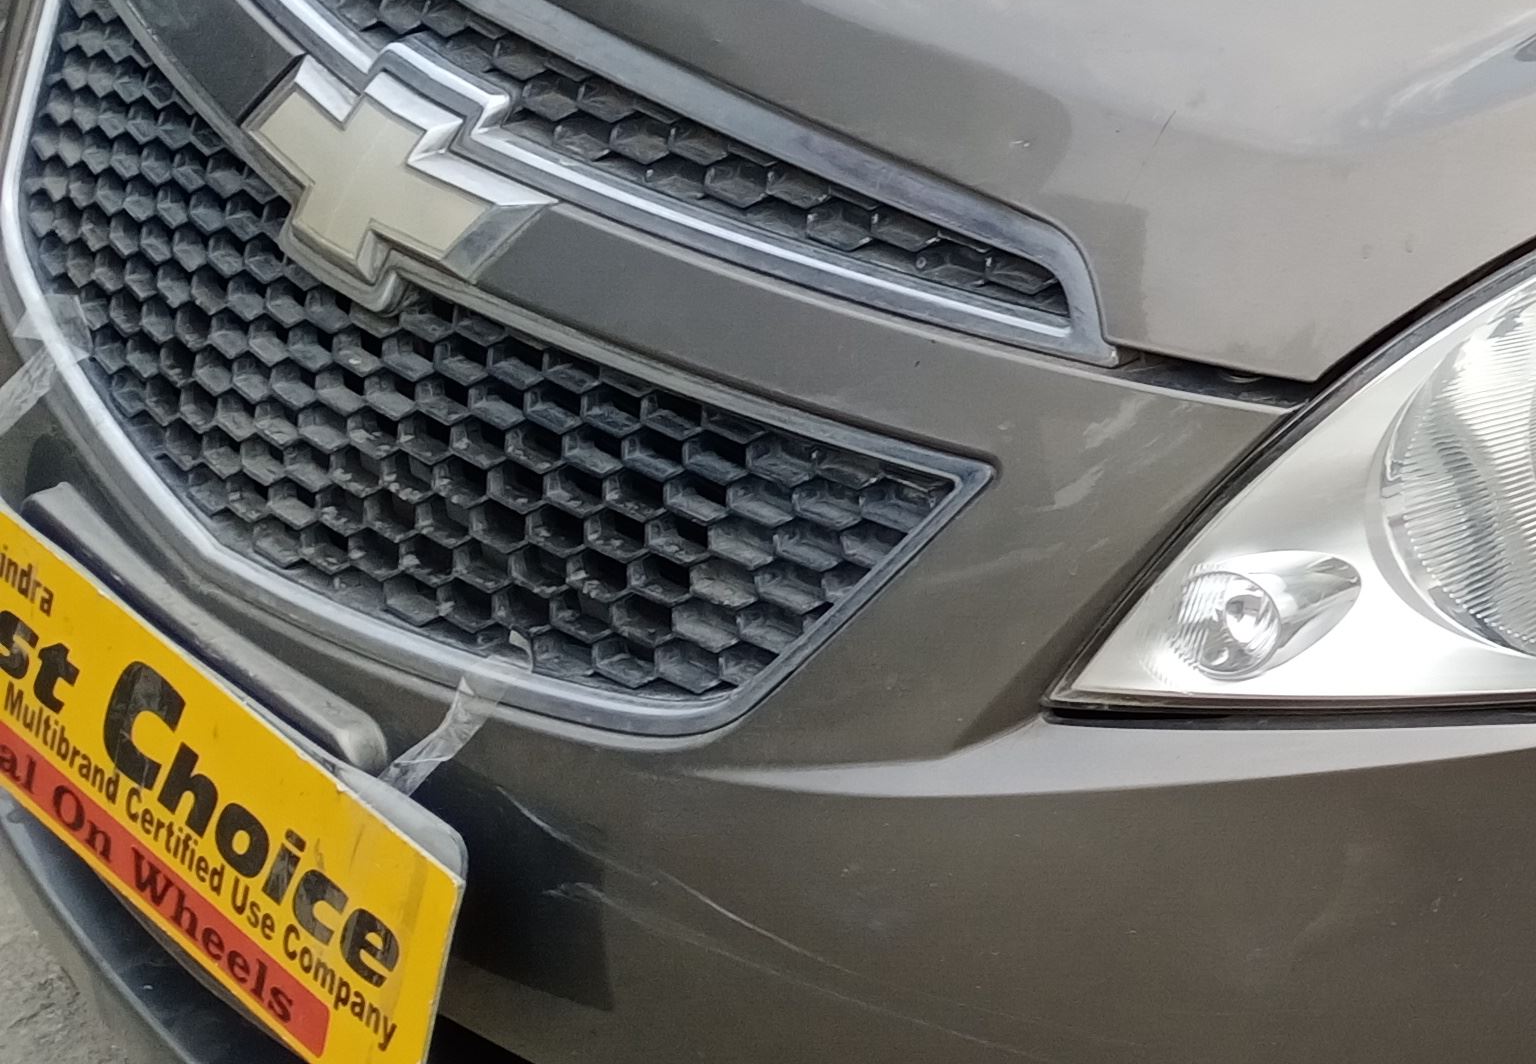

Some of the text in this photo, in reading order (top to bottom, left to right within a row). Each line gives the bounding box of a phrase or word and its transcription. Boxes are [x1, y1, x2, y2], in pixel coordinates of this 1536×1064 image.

[4, 681, 398, 1052] Multibrand Certified Use Company
[53, 784, 113, 862] On
[129, 843, 296, 1025] Wheels
[103, 660, 400, 988] Choice
